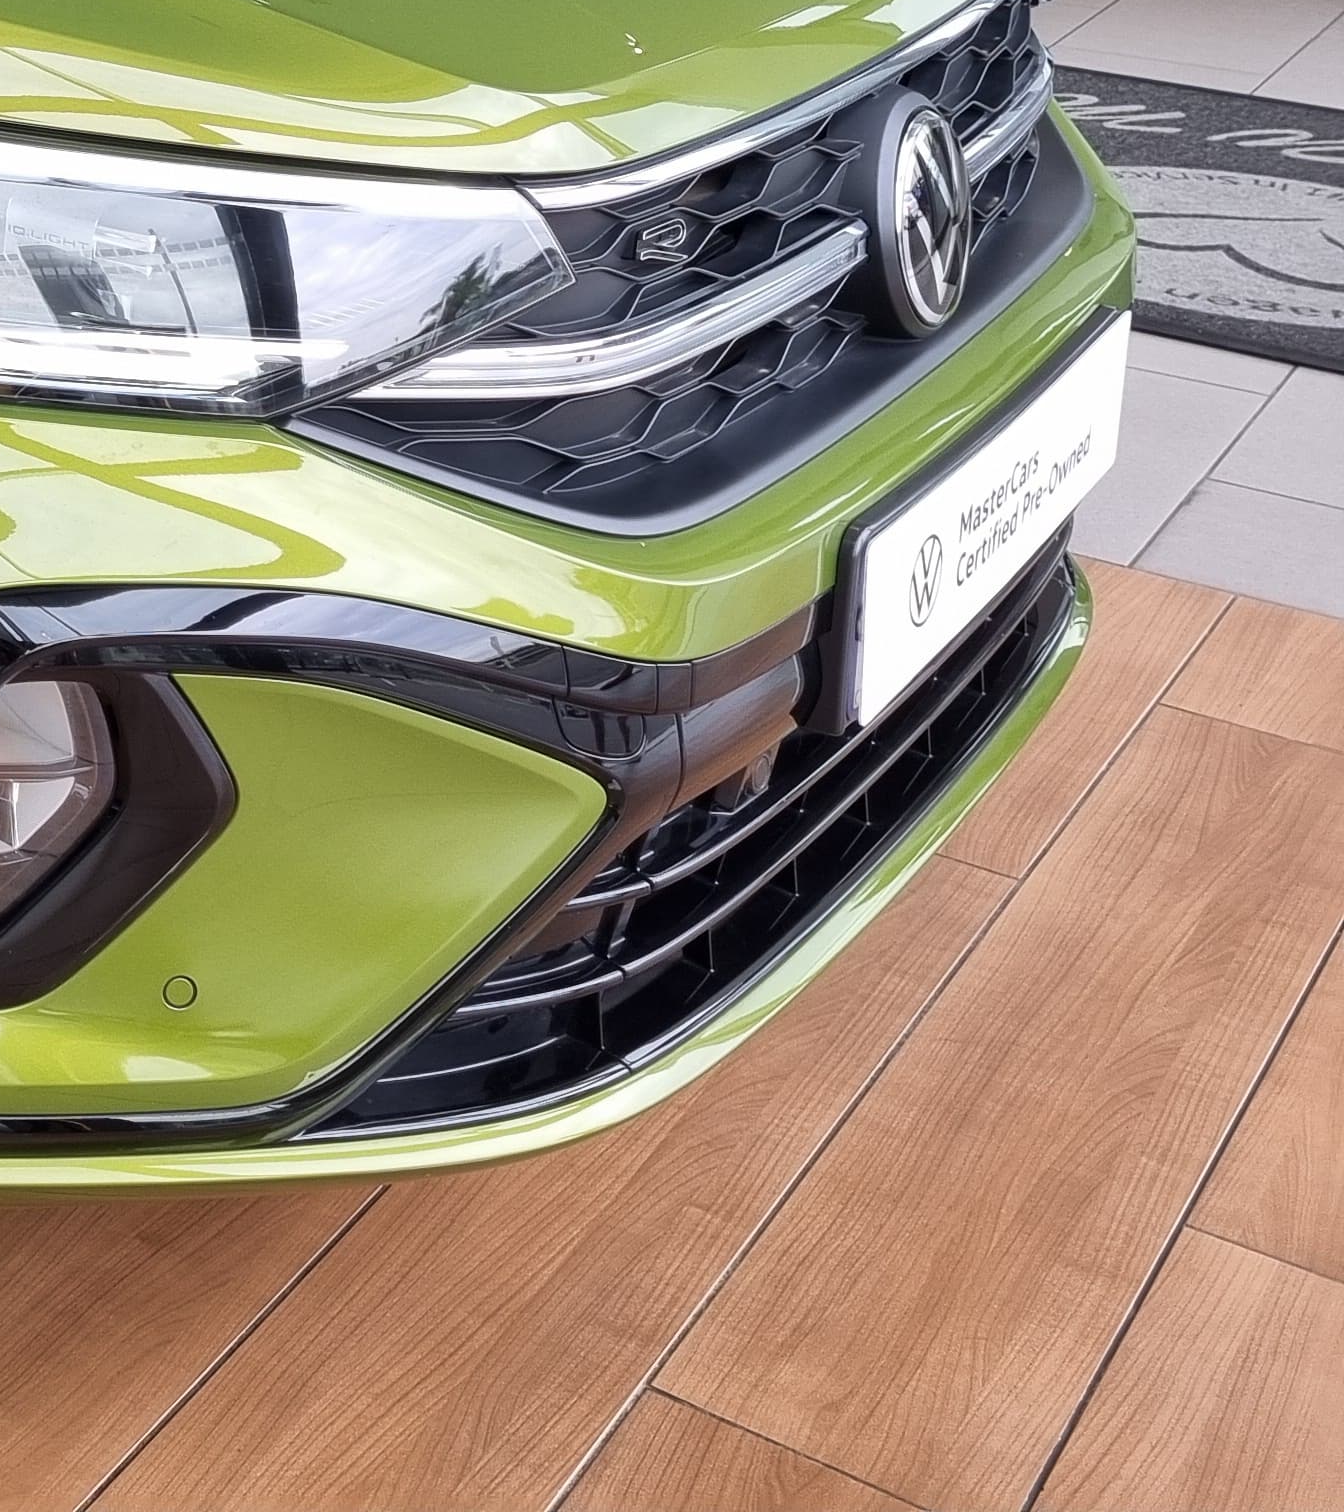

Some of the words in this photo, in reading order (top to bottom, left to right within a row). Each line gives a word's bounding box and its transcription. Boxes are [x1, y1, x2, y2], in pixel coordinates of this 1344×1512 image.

[956, 500, 1020, 587] Certified
[1021, 423, 1092, 525] Pre-Owned
[958, 449, 1040, 544] MasterCars
